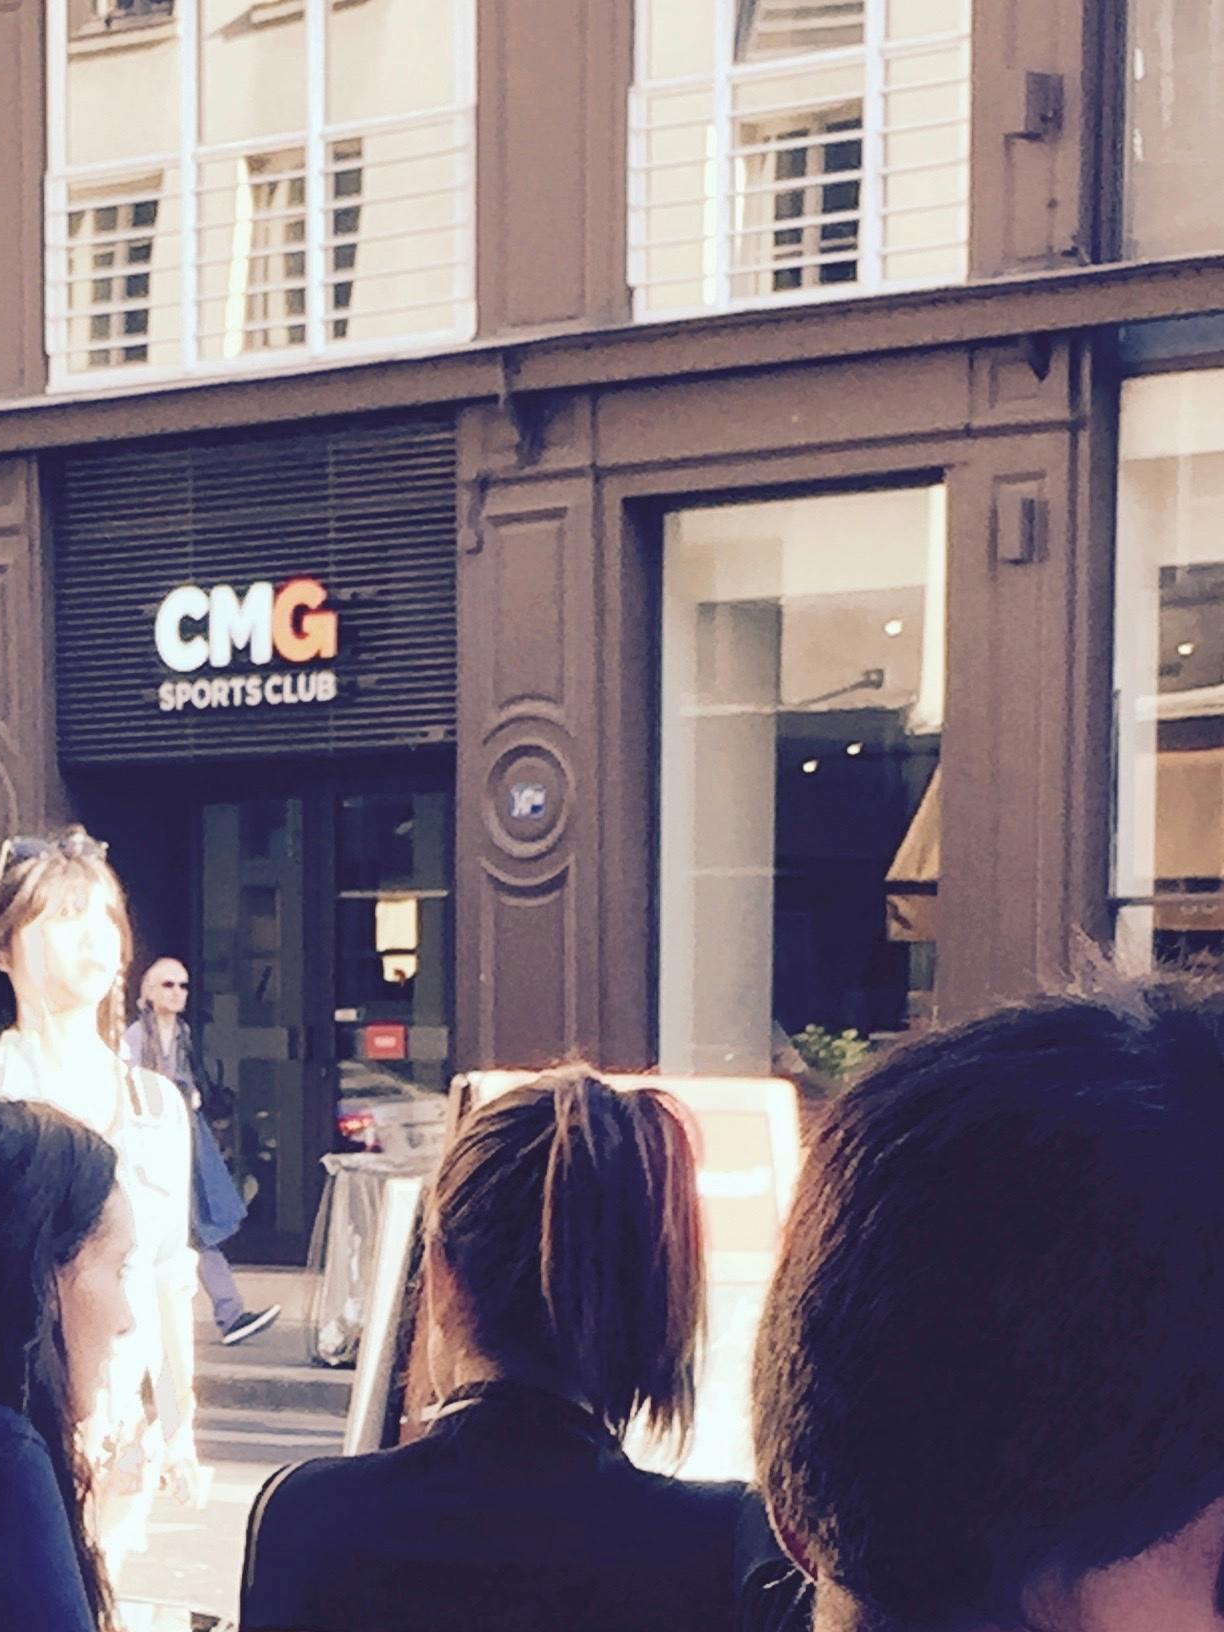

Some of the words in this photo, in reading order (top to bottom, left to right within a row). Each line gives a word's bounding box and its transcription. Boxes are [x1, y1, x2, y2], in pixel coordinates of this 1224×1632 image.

[154, 577, 338, 672] CMG
[158, 675, 263, 711] SPORTS
[264, 671, 337, 705] CLUB
